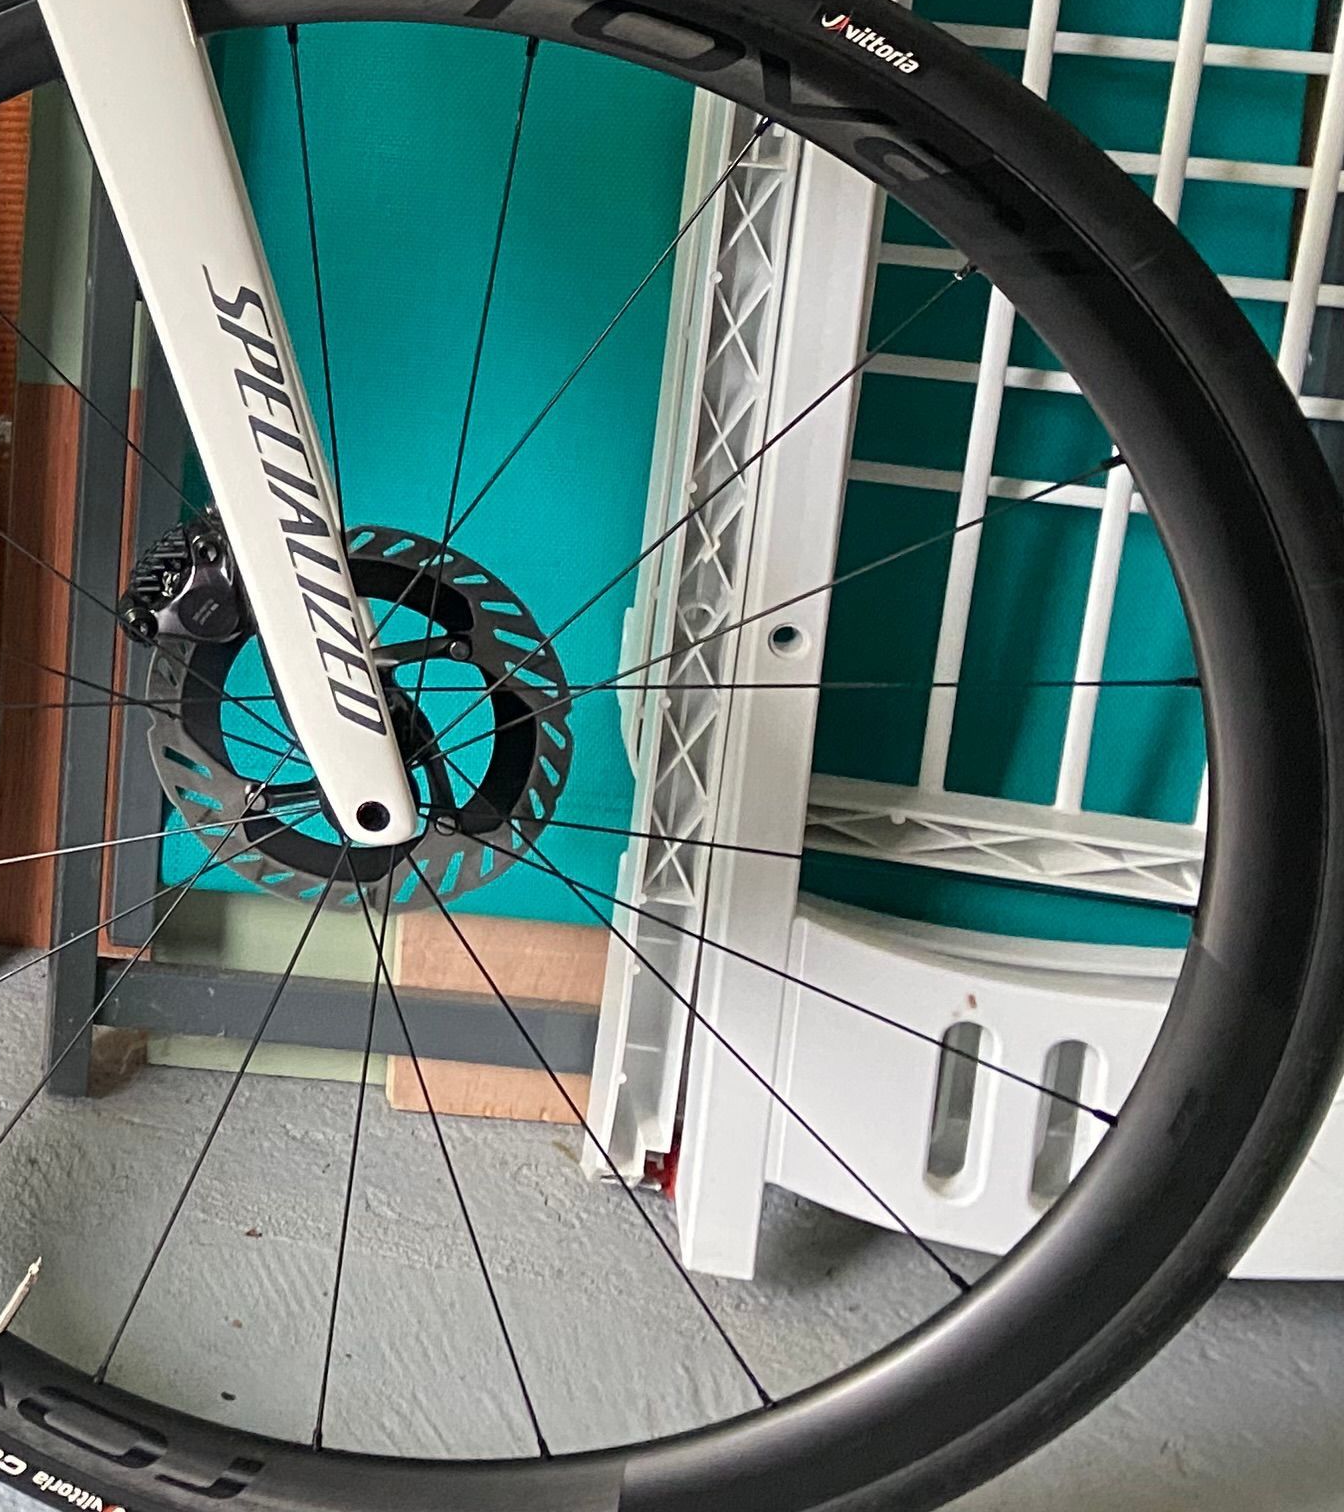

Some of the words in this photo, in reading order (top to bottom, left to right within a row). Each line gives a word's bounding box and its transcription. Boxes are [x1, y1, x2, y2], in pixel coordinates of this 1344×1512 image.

[842, 25, 921, 76] vittoria
[202, 264, 387, 736] SPECIALIZED
[32, 1470, 104, 1512] vittoria
